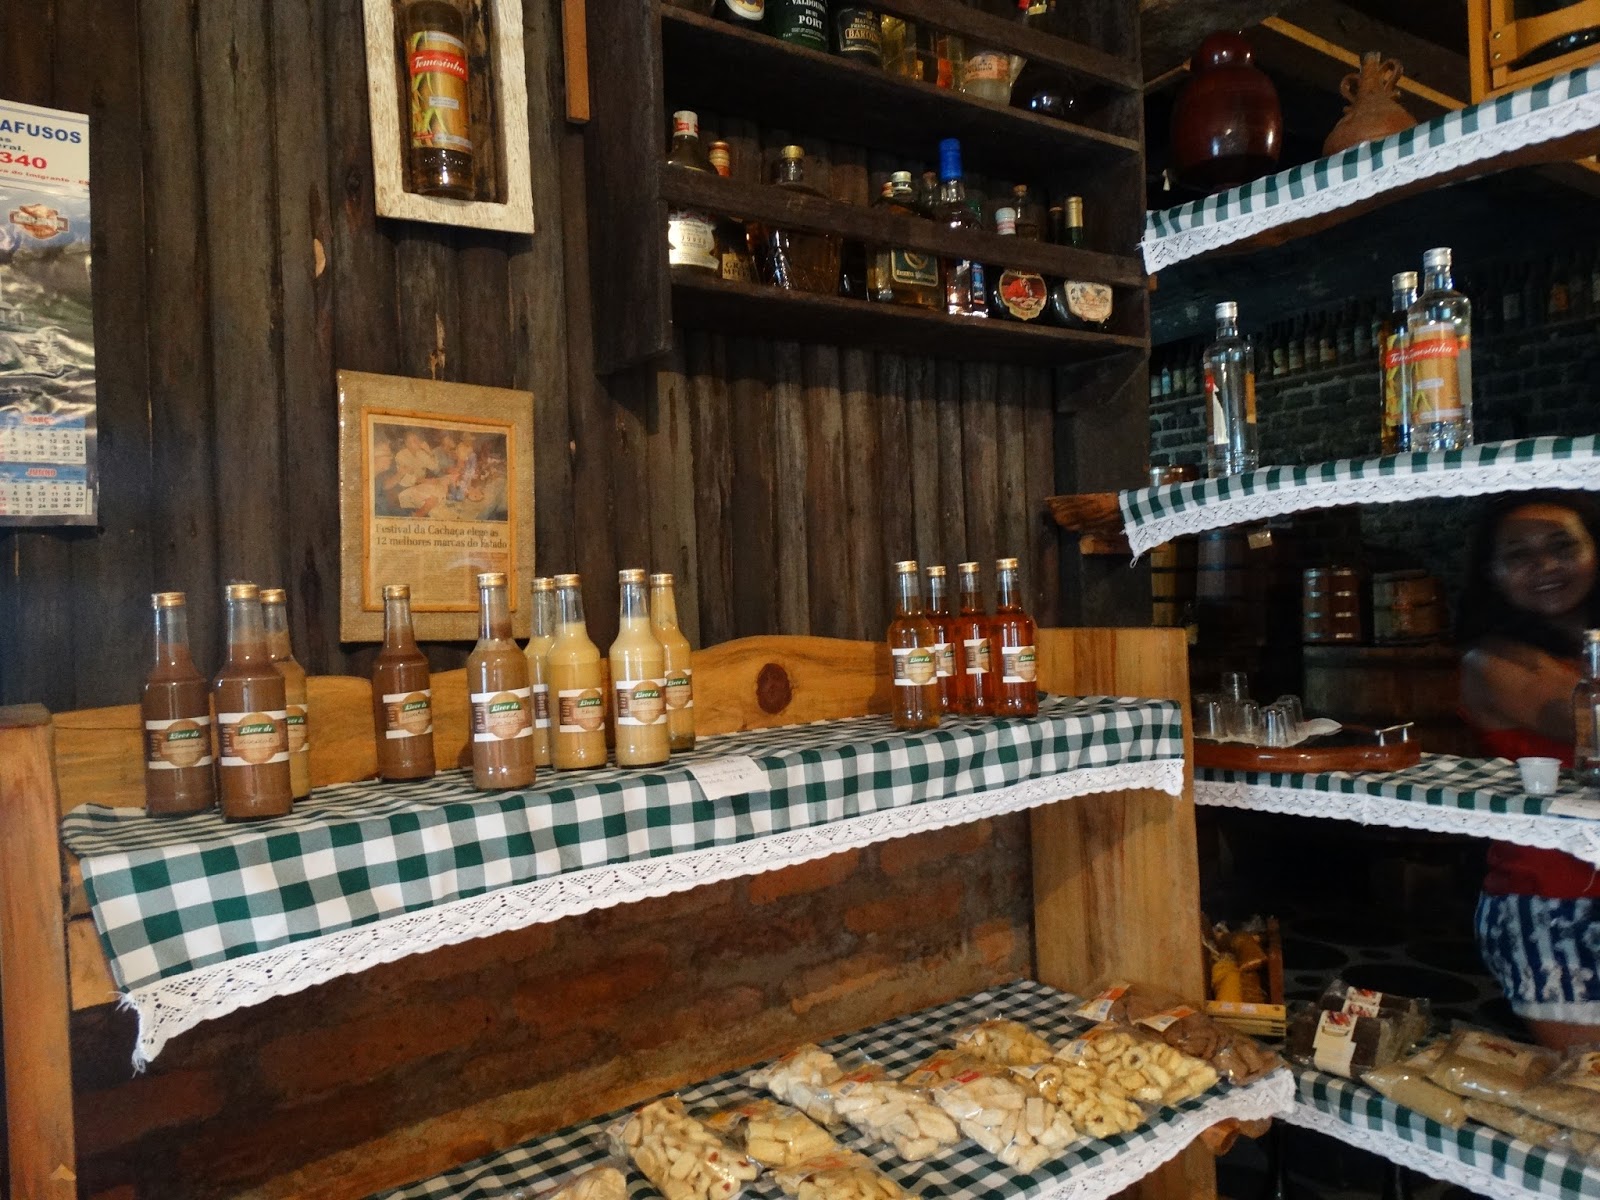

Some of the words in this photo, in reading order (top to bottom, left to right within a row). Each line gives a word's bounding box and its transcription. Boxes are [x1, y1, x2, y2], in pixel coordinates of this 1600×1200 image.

[798, 14, 823, 29] PORT
[0, 119, 82, 144] AFUSOS
[0, 151, 48, 169] 340
[375, 523, 411, 534] Festival
[414, 524, 426, 534] da
[428, 524, 465, 538] Cachaça
[467, 526, 489, 539] elege
[490, 529, 499, 537] as
[376, 536, 387, 545] 12
[389, 536, 431, 547] melhores
[434, 538, 465, 548] marcas
[480, 538, 507, 549] Estado
[240, 726, 263, 735] Licor
